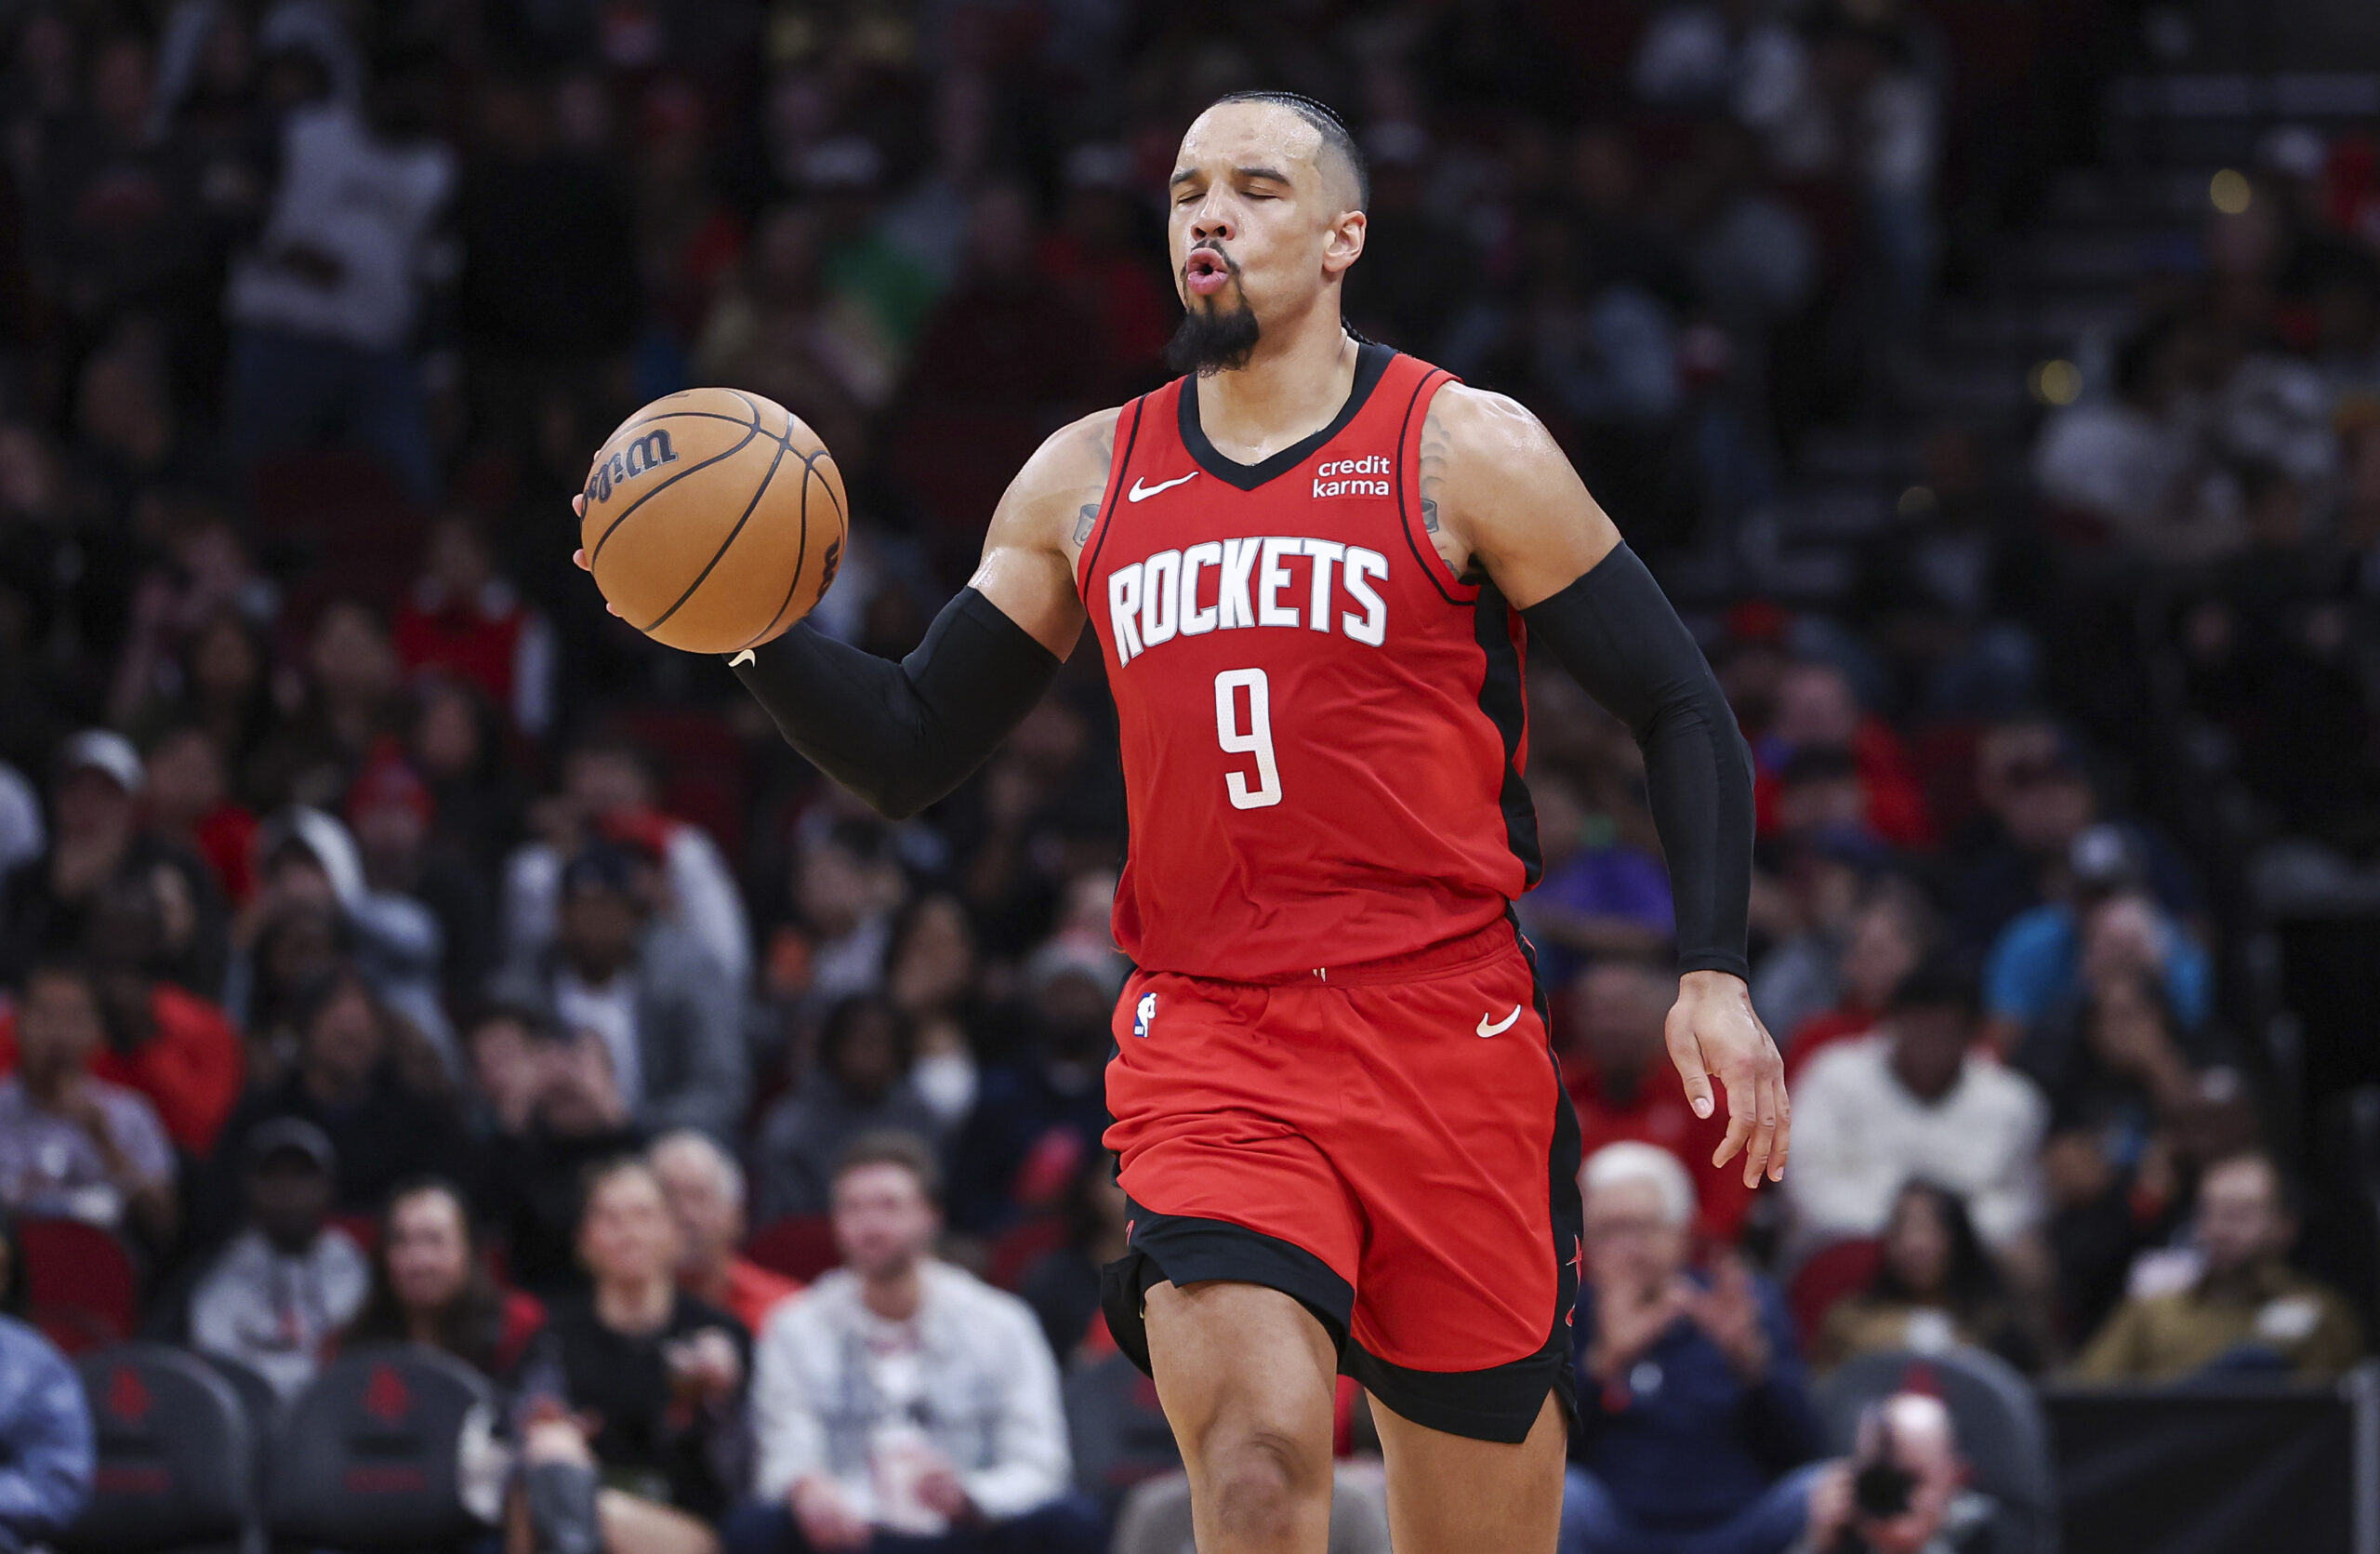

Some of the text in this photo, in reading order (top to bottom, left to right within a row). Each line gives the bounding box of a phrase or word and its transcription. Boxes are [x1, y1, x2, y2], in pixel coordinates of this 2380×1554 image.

[1313, 478, 1390, 498] karma
[1317, 455, 1391, 477] credit
[1107, 536, 1390, 669] ROCKETS
[1214, 667, 1283, 810] 9
